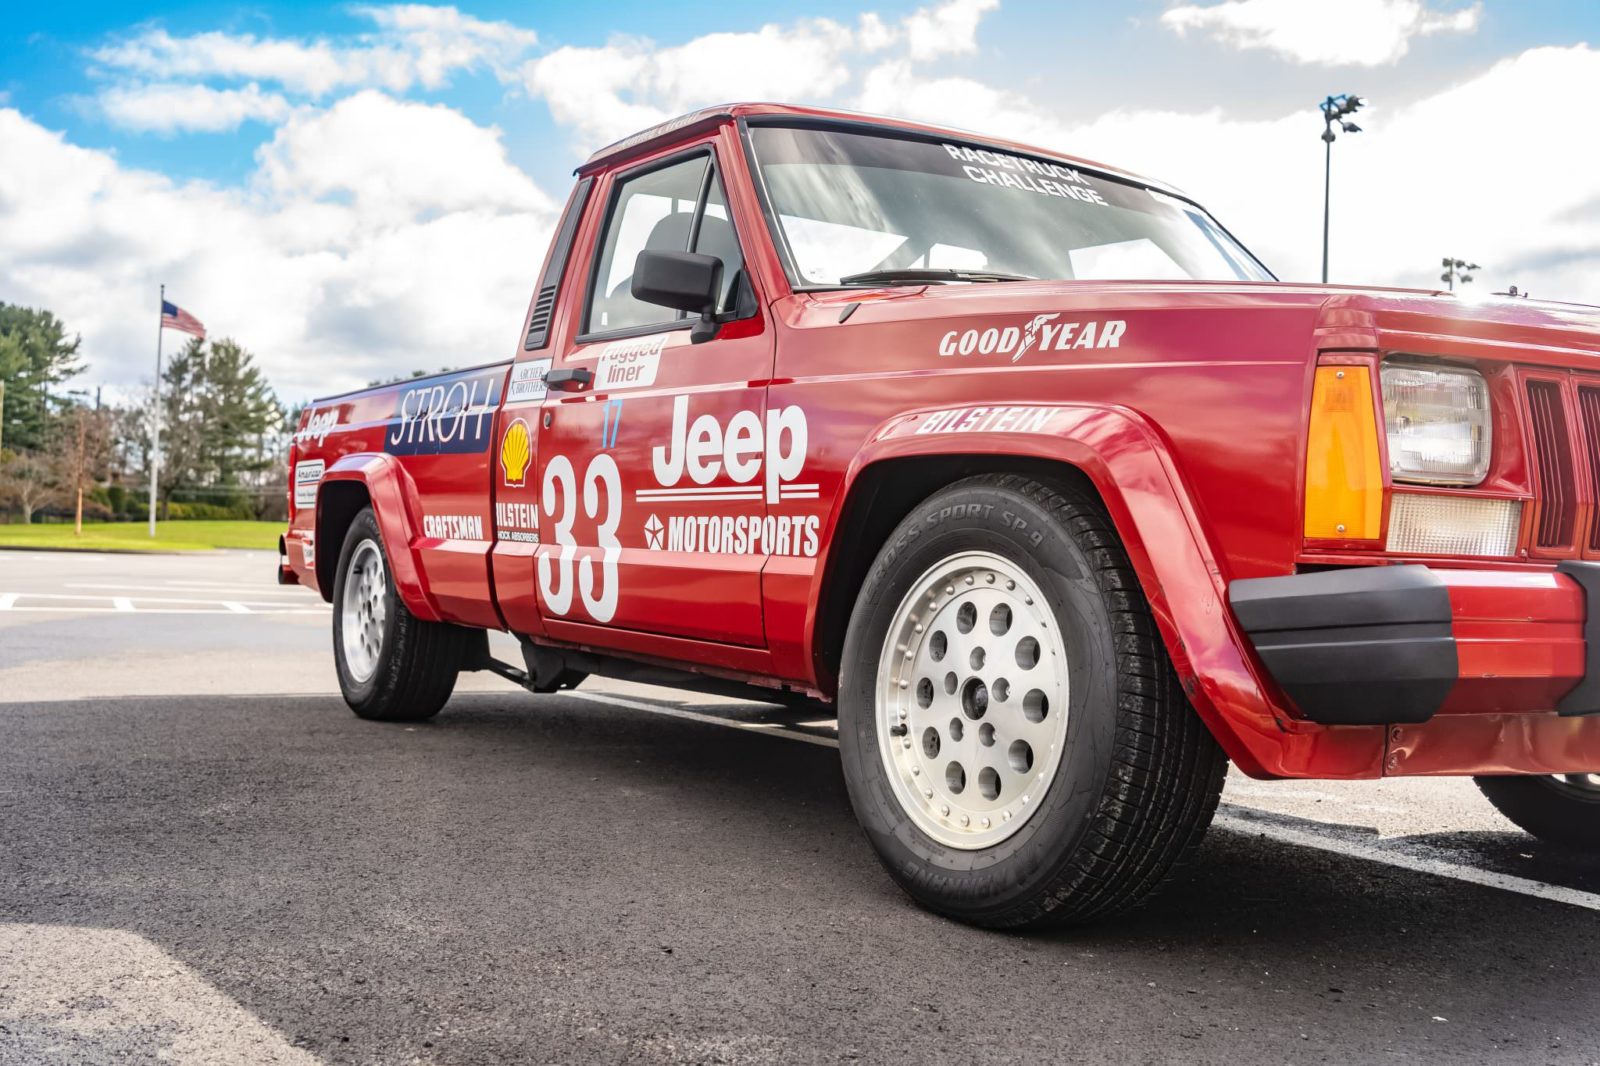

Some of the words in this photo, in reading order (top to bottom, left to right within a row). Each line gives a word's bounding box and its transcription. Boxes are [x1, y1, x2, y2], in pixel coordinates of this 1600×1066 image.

[942, 143, 1091, 186] RACETRUCK
[962, 165, 1110, 207] CHALLENGE
[601, 337, 666, 363] rugged
[607, 364, 646, 383] liner
[391, 379, 494, 446] STROH
[602, 399, 623, 448] 17
[914, 406, 1061, 435] BILSTEIN
[652, 395, 808, 504] Jeep
[423, 515, 483, 540] CRAFTSMAN
[668, 514, 820, 557] MOTORSPORTS
[926, 503, 994, 530] SPORT
[538, 453, 622, 623] 33
